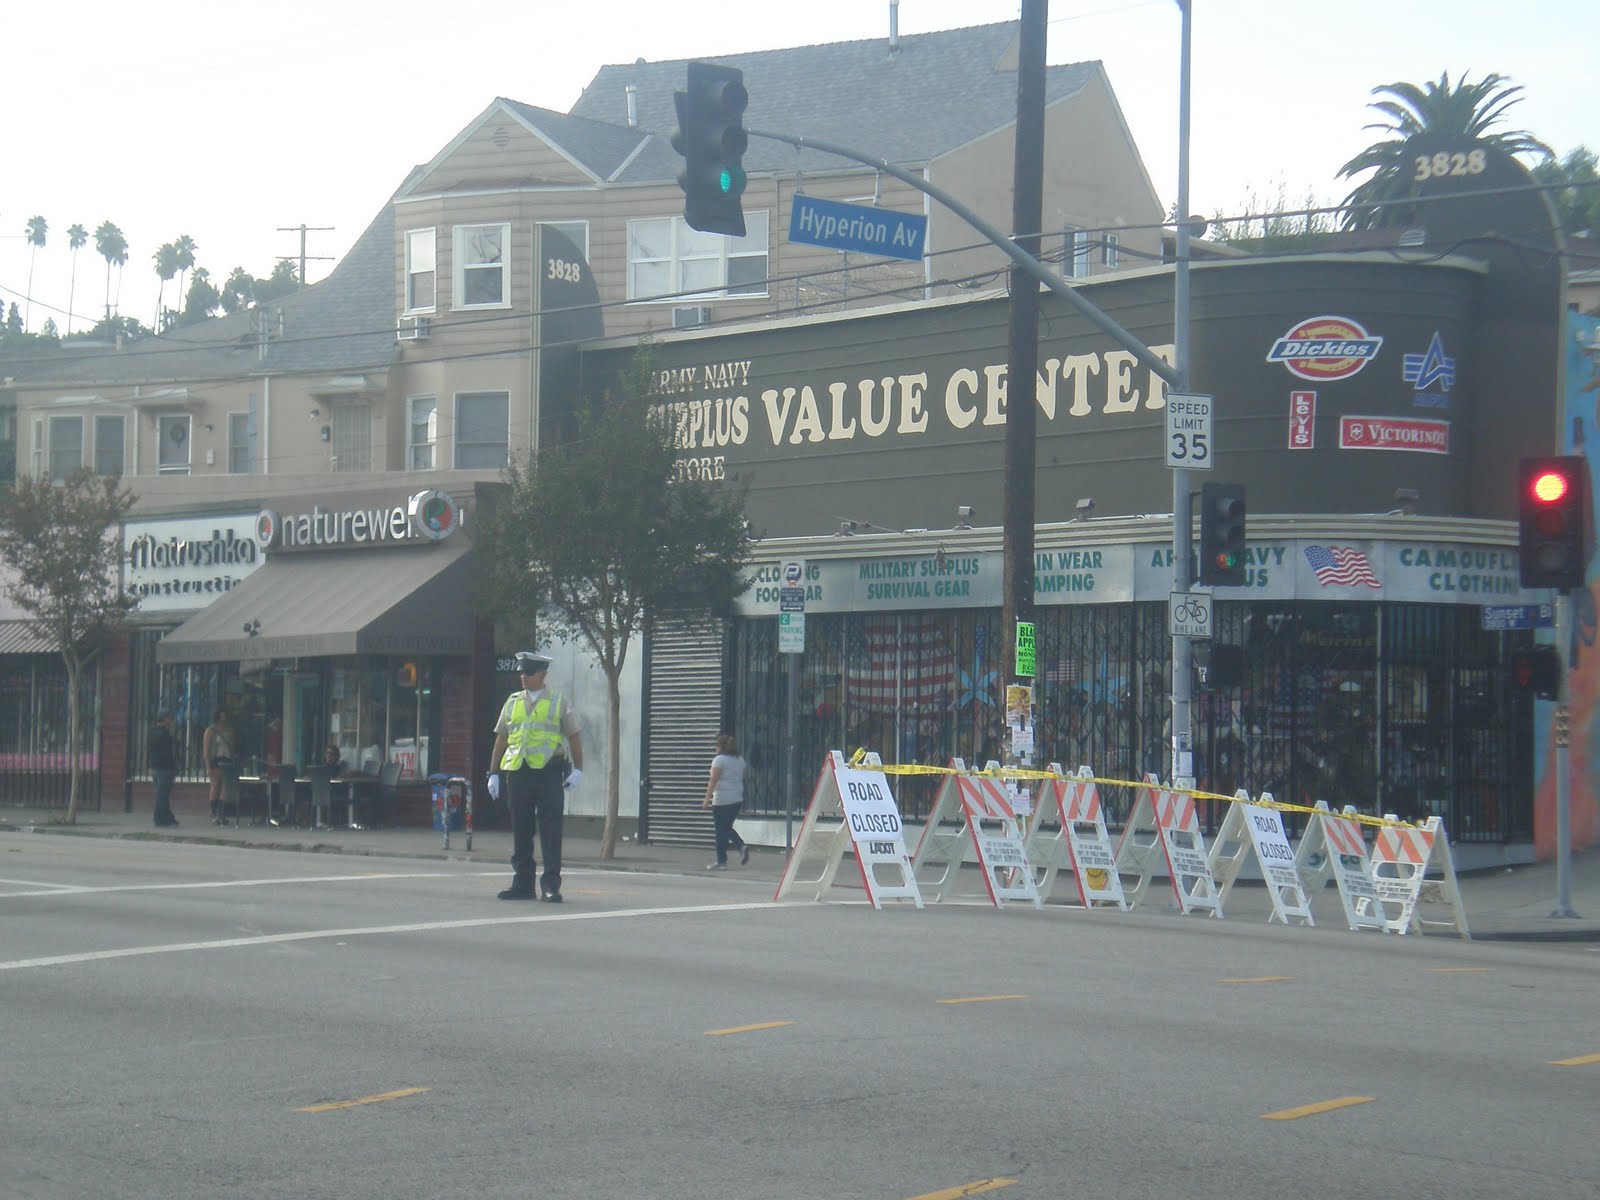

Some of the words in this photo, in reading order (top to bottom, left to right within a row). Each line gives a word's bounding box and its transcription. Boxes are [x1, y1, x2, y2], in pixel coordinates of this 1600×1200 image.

[1414, 149, 1487, 181] 3828
[799, 206, 886, 243] Hyperion
[892, 221, 917, 248] Av
[547, 258, 580, 282] 3828
[1280, 341, 1370, 356] Dickies
[646, 367, 697, 395] RMY
[704, 361, 752, 390] NAVY
[761, 372, 929, 445] VALUE
[1169, 402, 1209, 415] SPEED
[1174, 418, 1204, 430] LIMIT
[1171, 433, 1208, 460] 35
[665, 456, 726, 484] TORE
[281, 496, 420, 546] naturewel
[1058, 551, 1103, 570] WEAR
[1243, 547, 1286, 566] AVY
[1400, 548, 1520, 571] CAMOUFL
[757, 564, 821, 583] CLONG
[859, 561, 917, 580] MILITARY
[128, 575, 242, 598] constructi
[867, 581, 930, 600] SURVIVAL
[934, 579, 971, 597] GEAR
[1034, 573, 1095, 592] AMPING
[756, 585, 823, 602] FOOAR
[782, 614, 788, 624] 2
[1484, 607, 1525, 620] Sunset
[1174, 625, 1188, 633] BIKE
[1190, 626, 1207, 634] LANE
[394, 753, 415, 768] ATM
[848, 782, 883, 801] ROAD
[851, 814, 899, 833] CLOSED
[1254, 816, 1279, 833] ROAD
[1260, 841, 1293, 861] CLOSED
